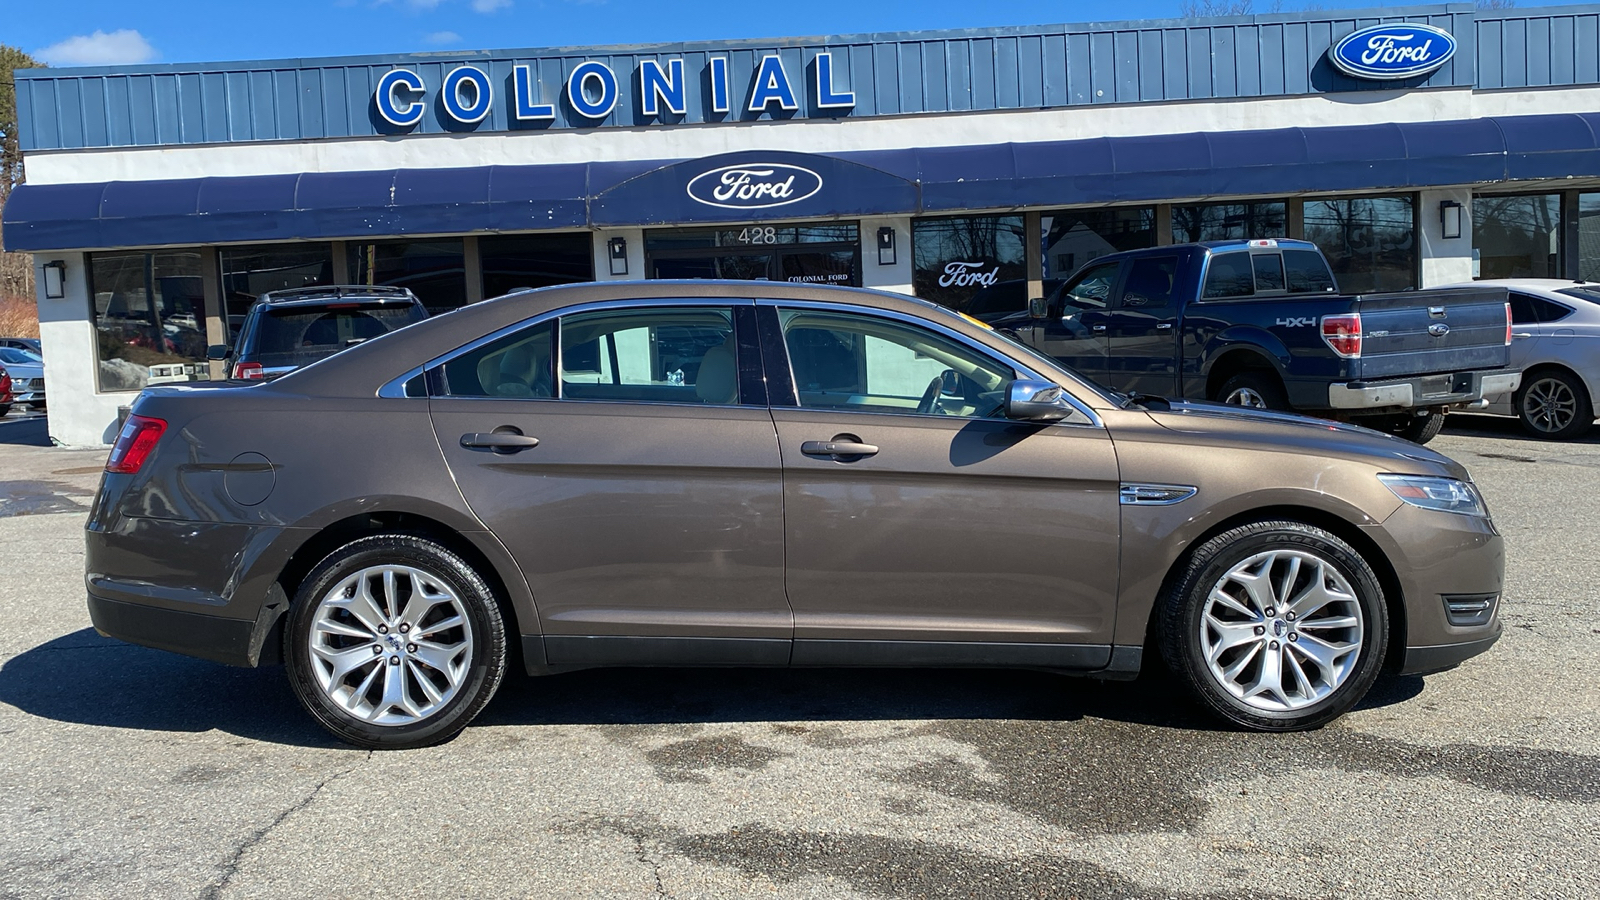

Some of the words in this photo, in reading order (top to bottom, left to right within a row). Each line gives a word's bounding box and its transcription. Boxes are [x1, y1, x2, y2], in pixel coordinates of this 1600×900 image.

[1361, 33, 1433, 65] Ford
[375, 52, 856, 127] COLONIAL
[713, 169, 796, 201] Ford
[738, 226, 776, 245] 428
[788, 275, 826, 283] COLONIAL
[828, 273, 848, 281] FORD
[938, 261, 1000, 288] Ford
[1265, 534, 1328, 550] EAGLE
